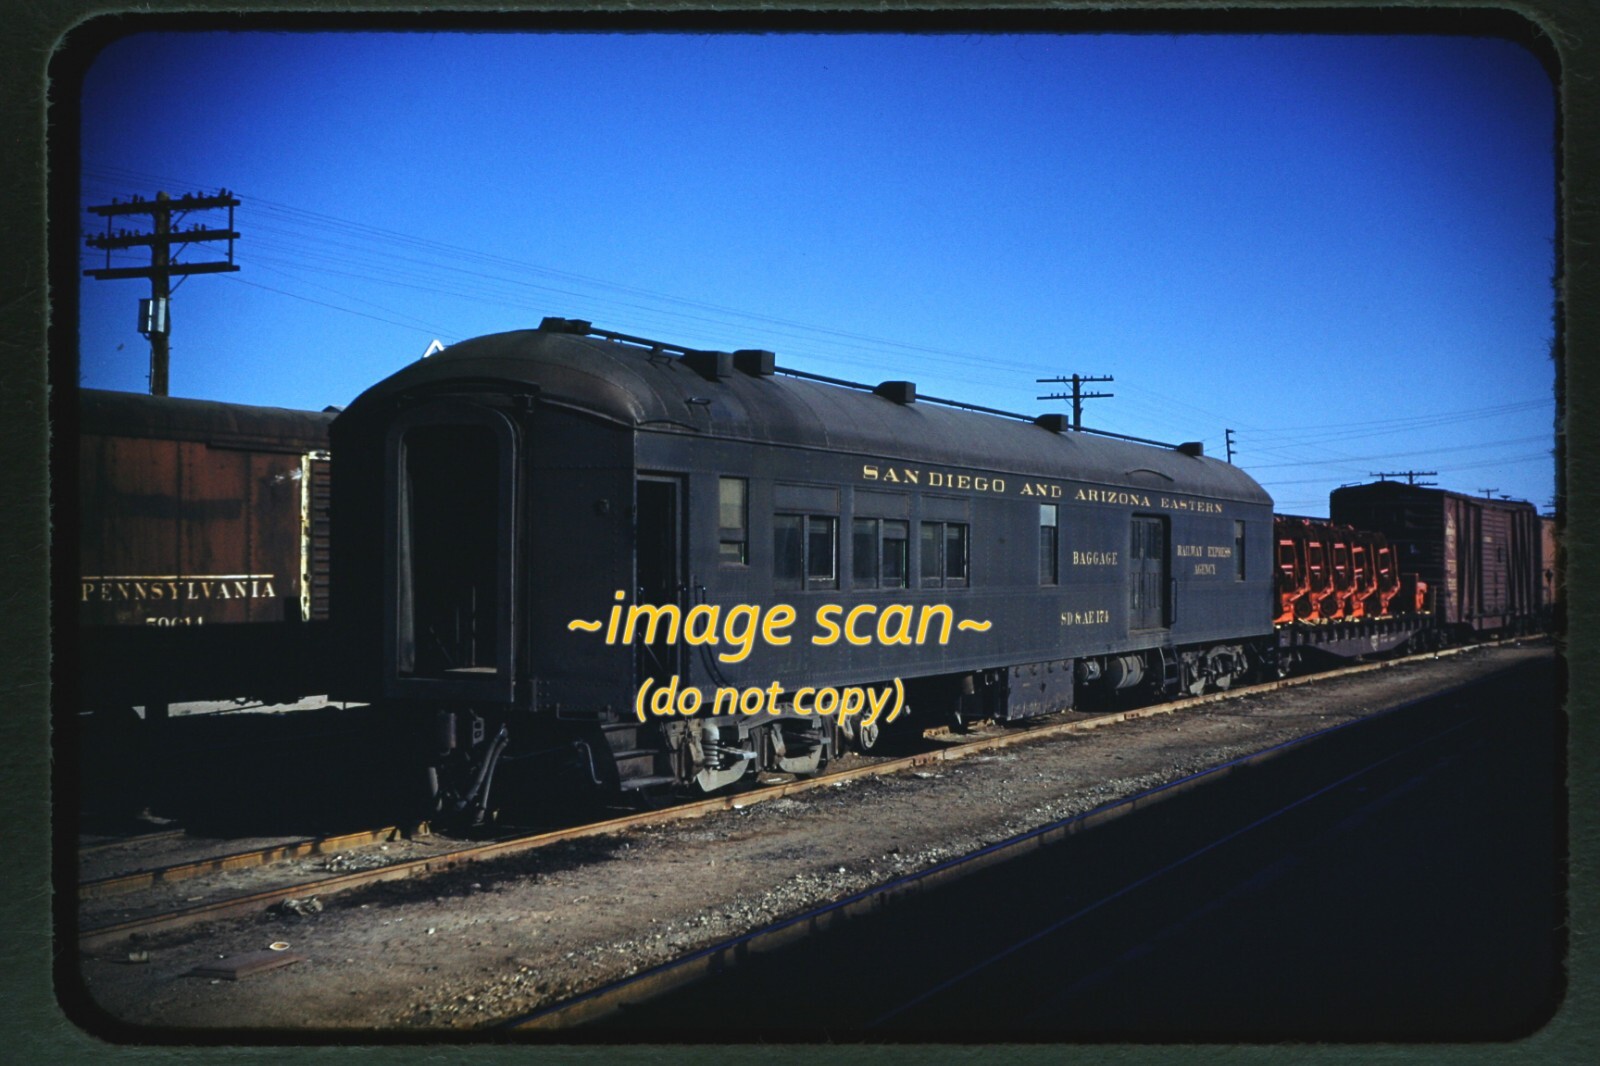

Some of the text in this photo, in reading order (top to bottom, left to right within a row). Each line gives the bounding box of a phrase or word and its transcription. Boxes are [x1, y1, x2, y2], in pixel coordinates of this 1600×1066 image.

[863, 465, 1224, 514] SAN DIEGO AND ARIZONA EASTERN
[1072, 551, 1118, 566] BAGGAGE
[1177, 544, 1232, 558] RAILWAY EXPRESS
[1194, 563, 1216, 575] AGENCY
[81, 580, 276, 602] PENNSYLVANIA
